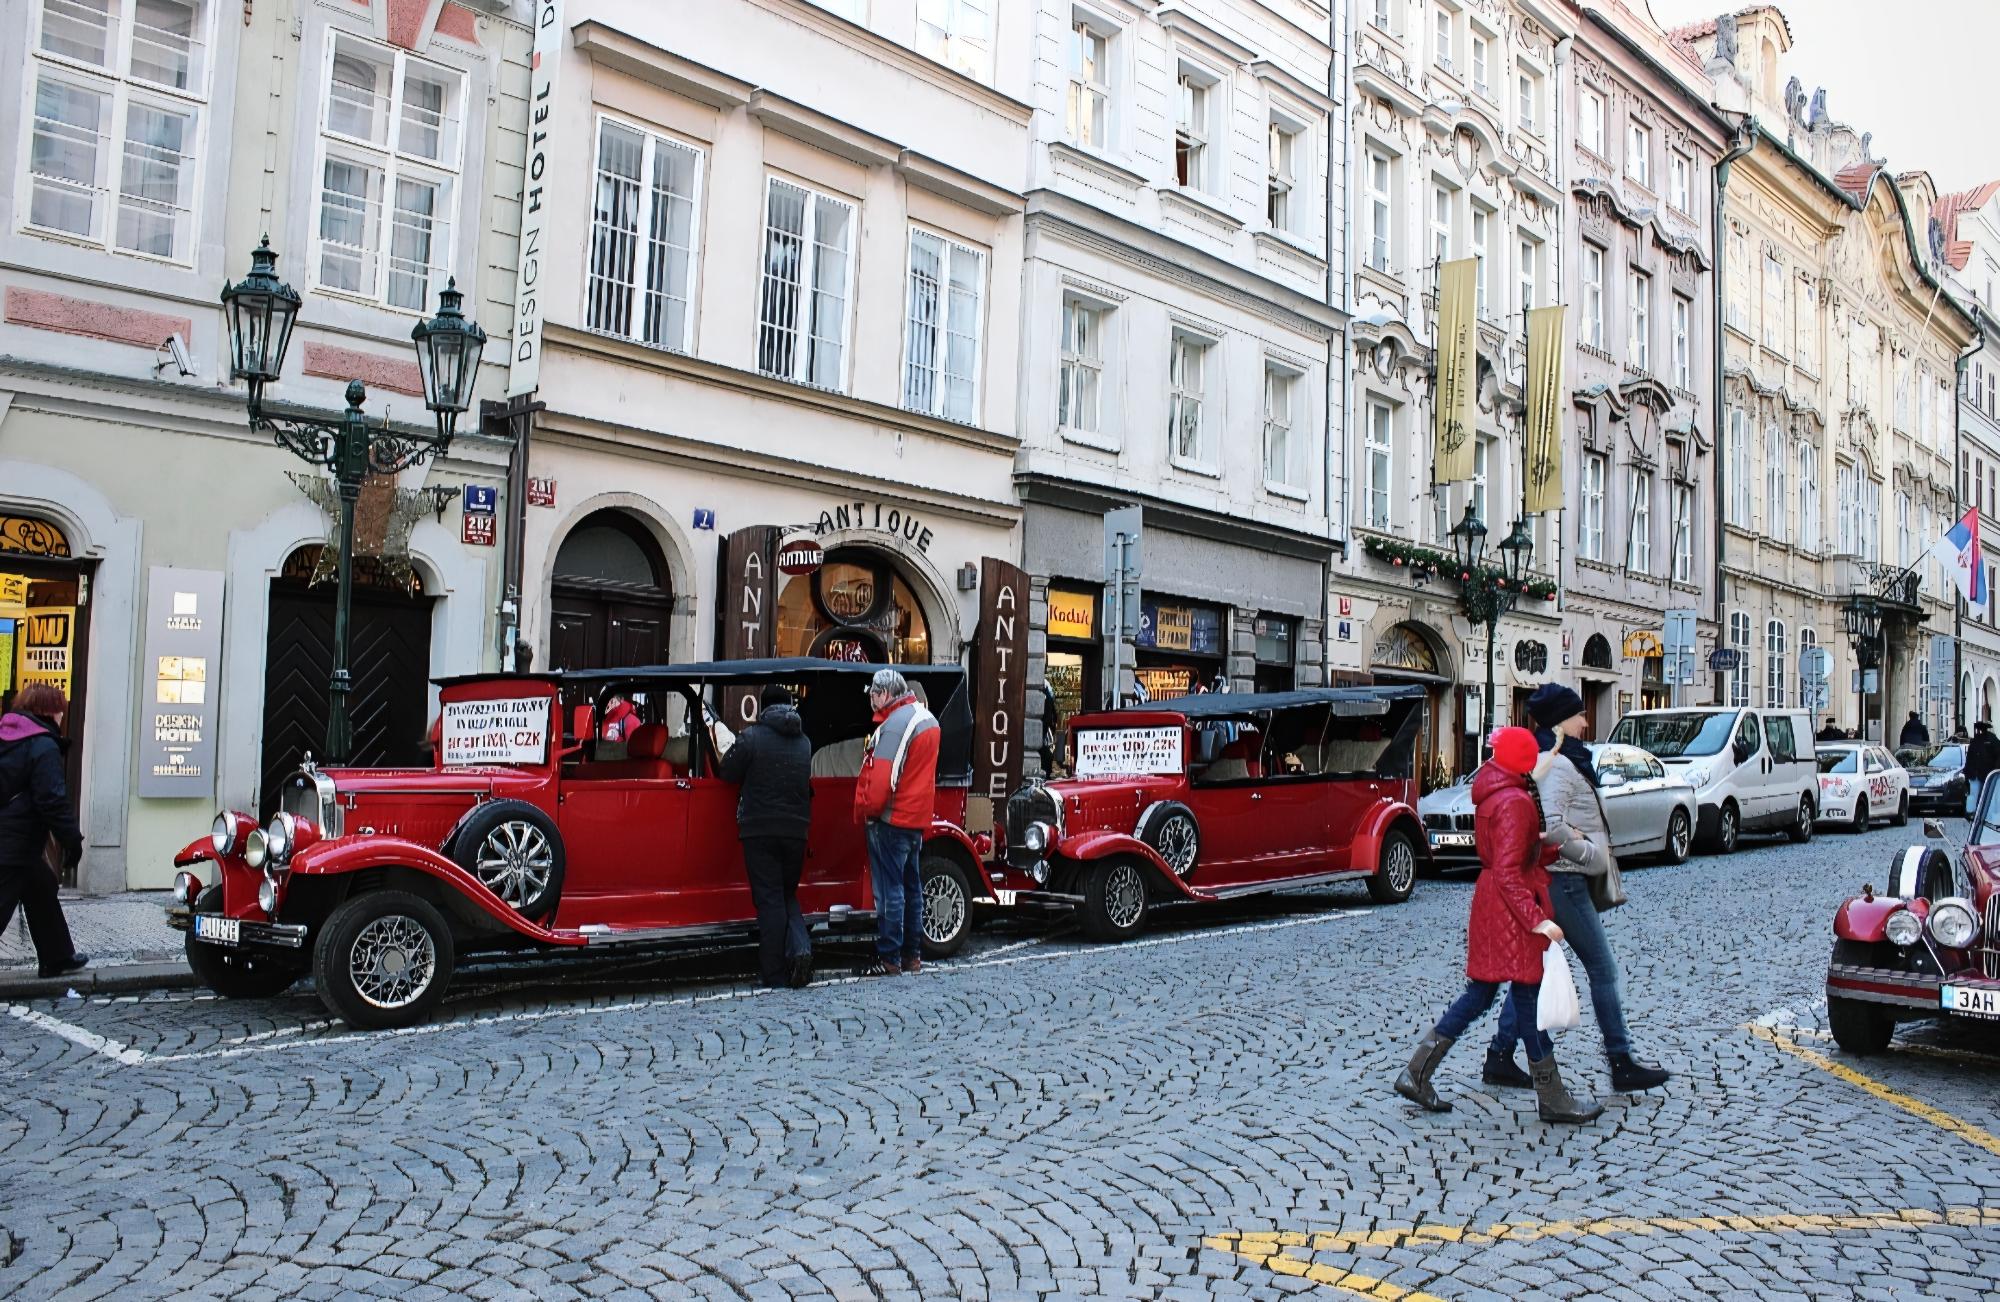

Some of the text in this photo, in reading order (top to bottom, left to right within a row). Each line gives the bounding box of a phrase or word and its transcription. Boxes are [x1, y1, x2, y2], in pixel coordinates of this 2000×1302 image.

[518, 227, 540, 363] DESIGN
[529, 80, 551, 214] HOTEL
[478, 490, 486, 503] 5
[468, 517, 492, 531] 202
[815, 502, 934, 554] ANTIQUE
[1049, 603, 1090, 626] Kodak
[989, 585, 1016, 798] ANTIQUE
[514, 731, 541, 747] CZK
[1959, 991, 1994, 1012] 3AH
